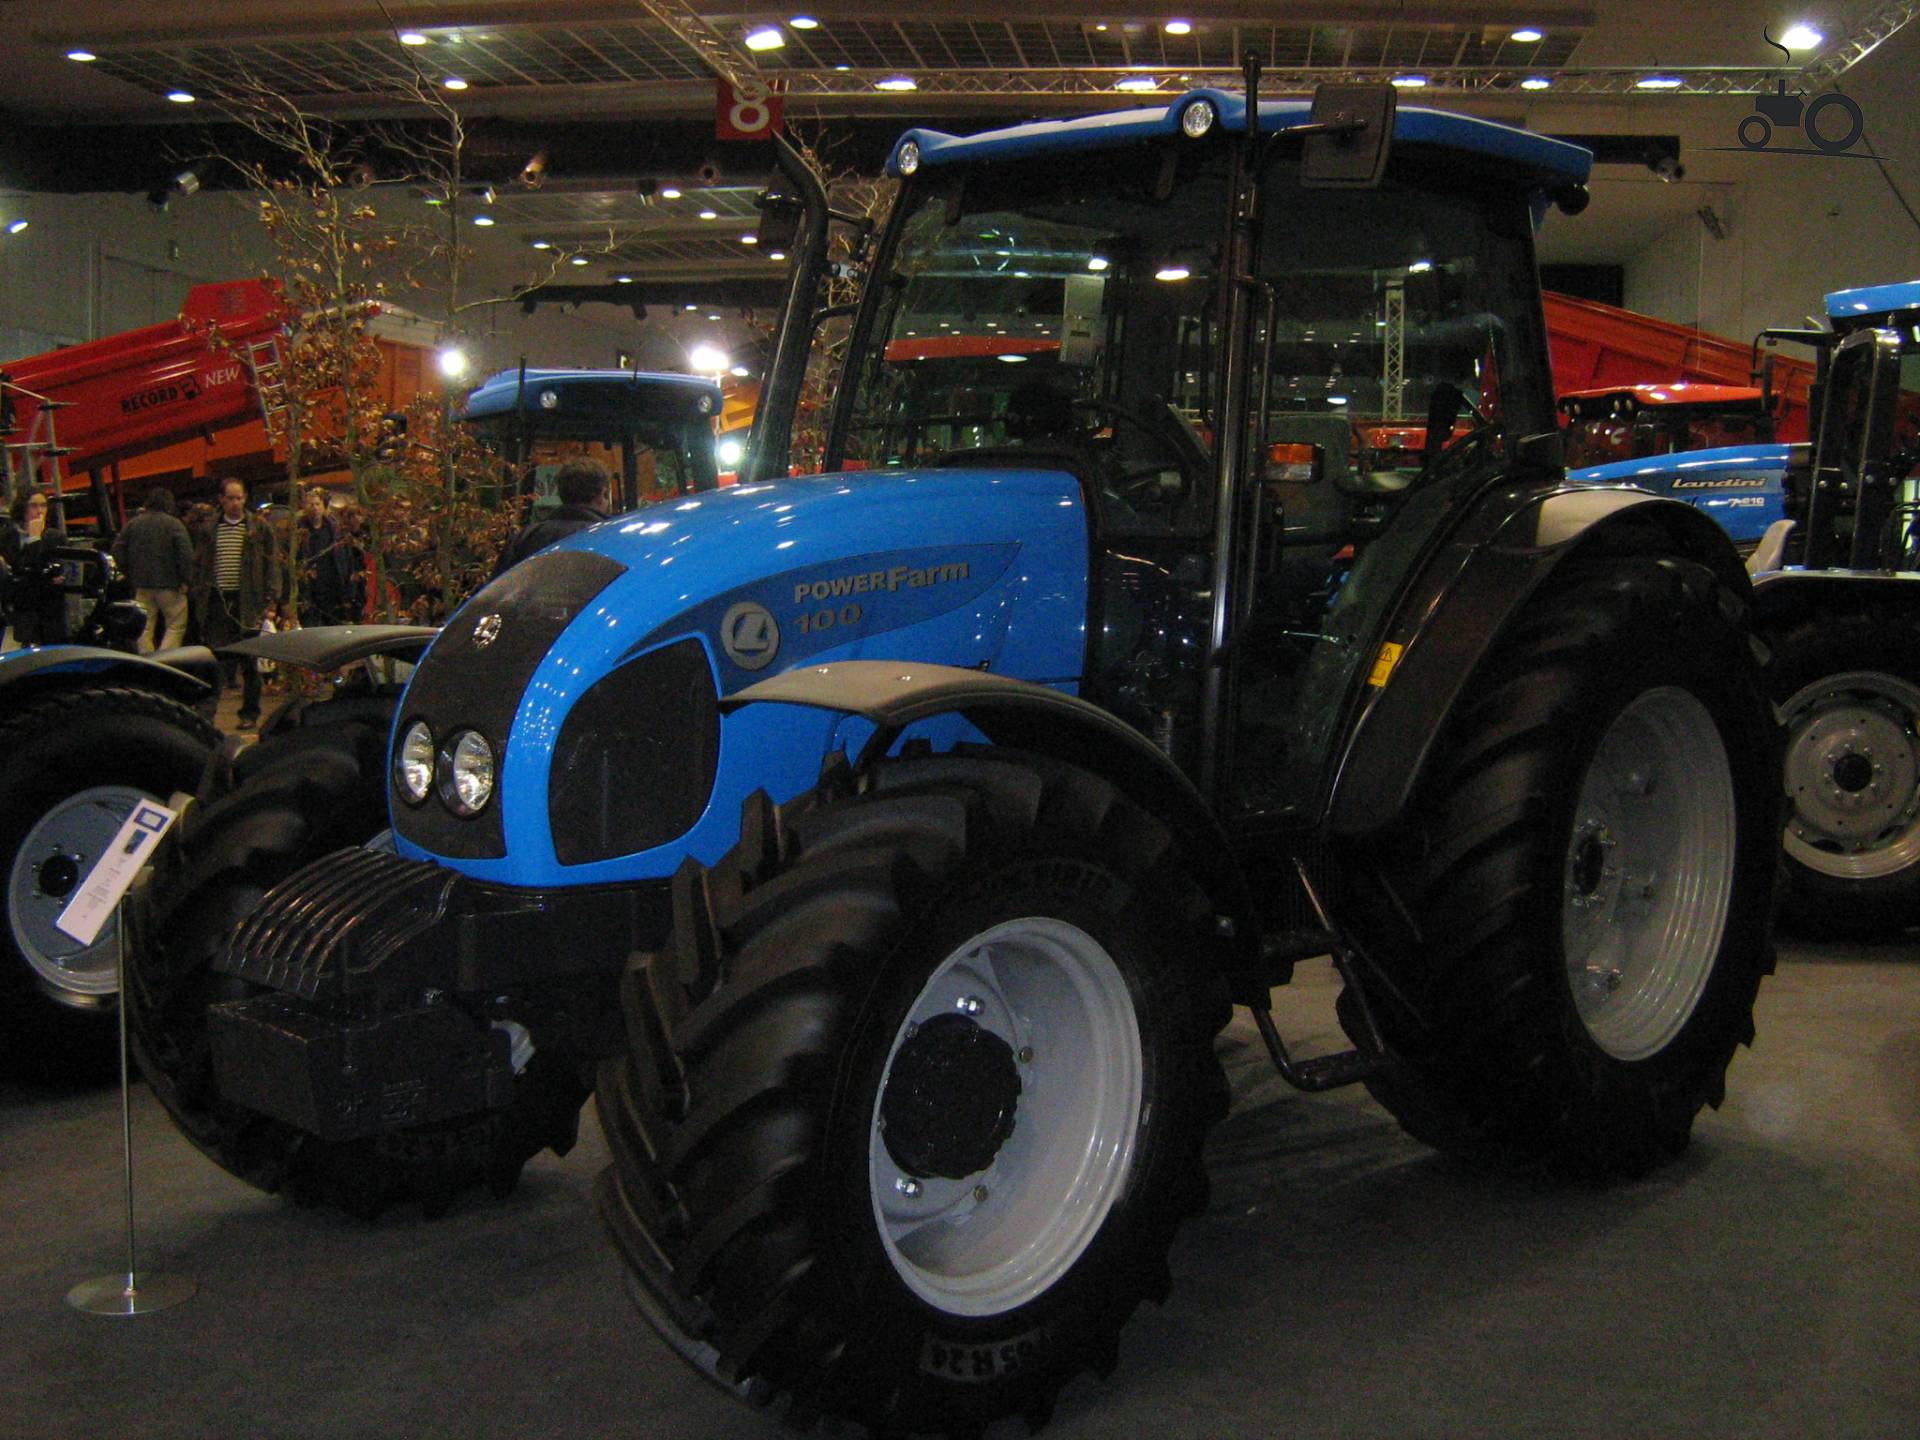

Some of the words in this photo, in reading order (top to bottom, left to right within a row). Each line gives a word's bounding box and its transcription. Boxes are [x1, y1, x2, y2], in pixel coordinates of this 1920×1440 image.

[730, 80, 770, 133] 8
[205, 366, 241, 388] NEW
[121, 386, 178, 413] RECORD
[1671, 478, 1768, 489] Landini
[793, 603, 862, 635] 100
